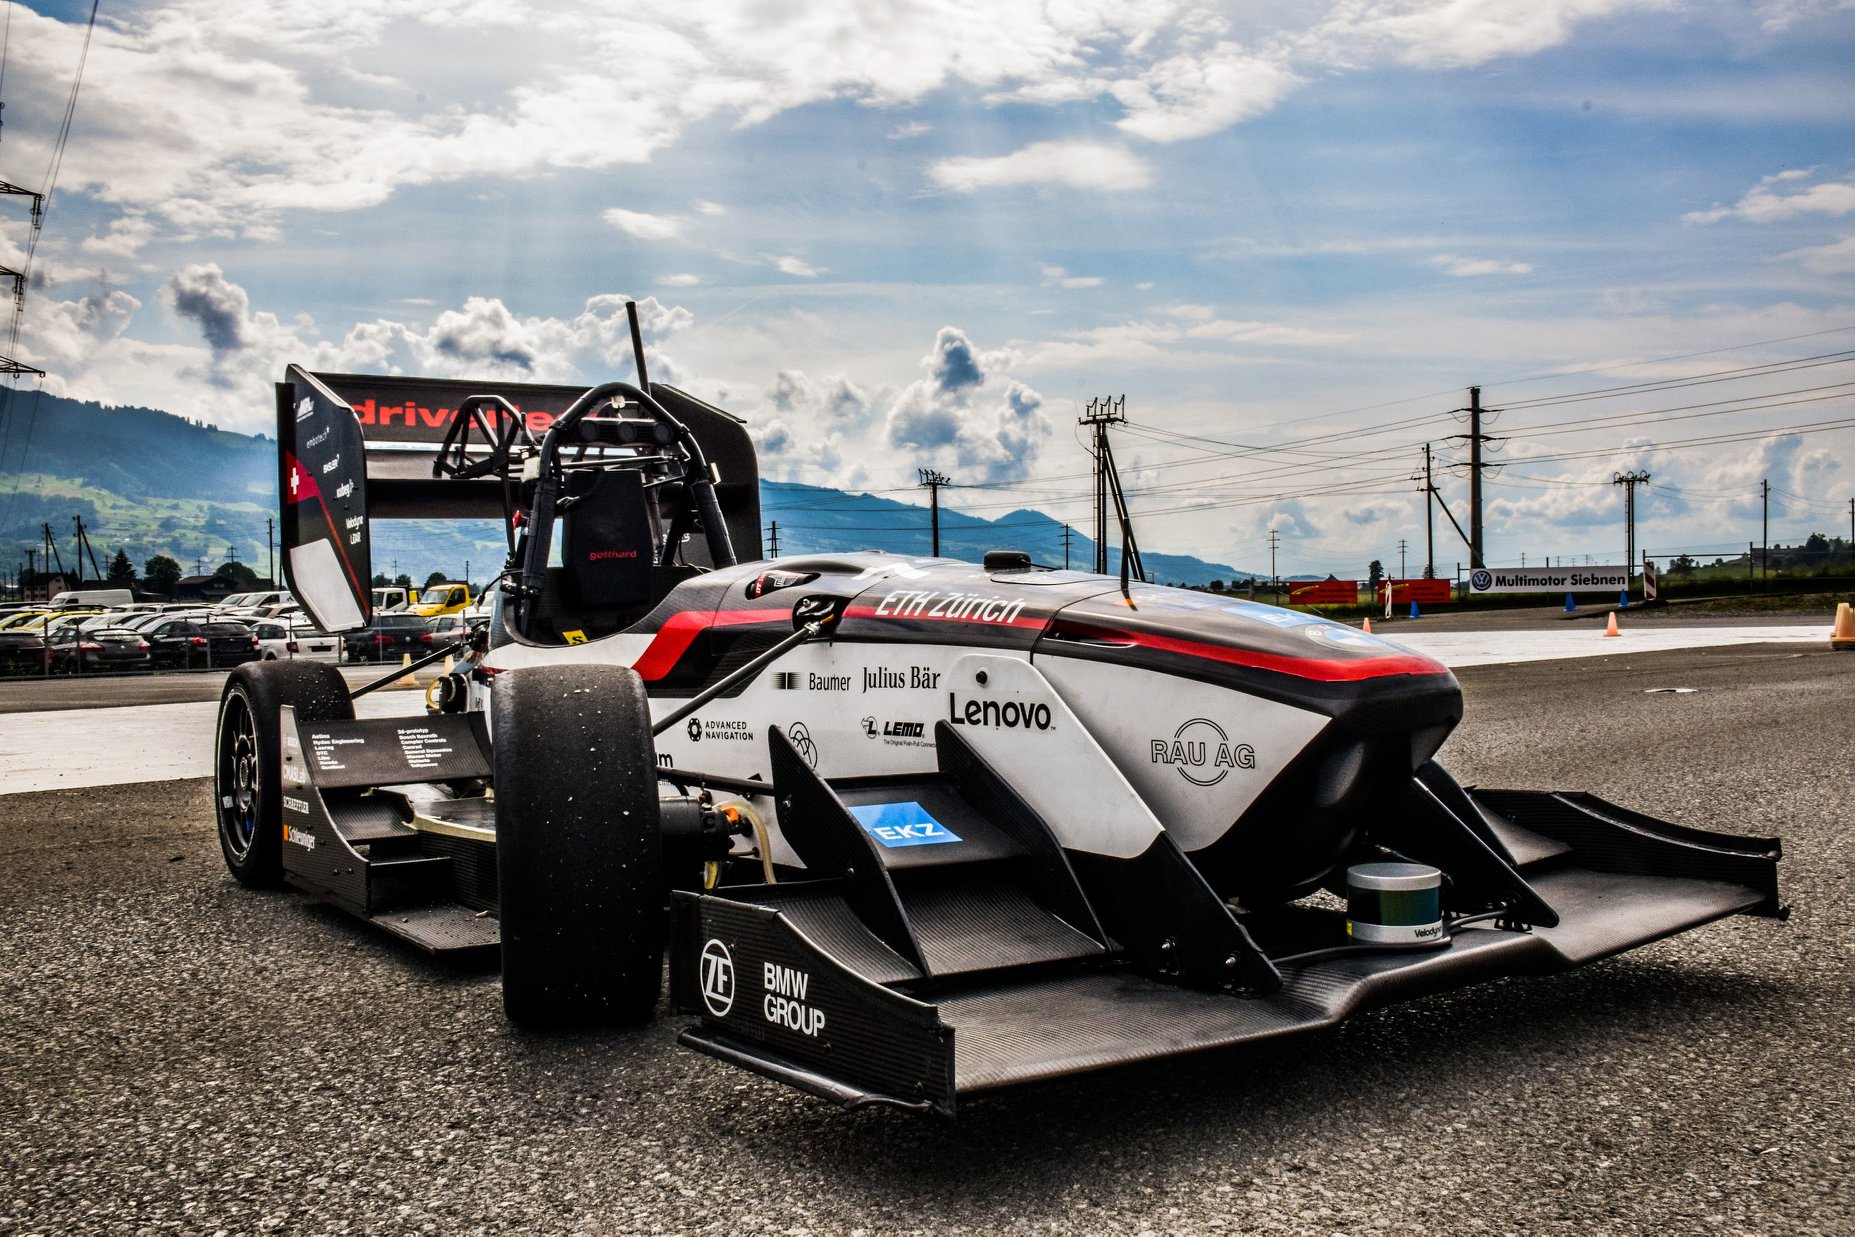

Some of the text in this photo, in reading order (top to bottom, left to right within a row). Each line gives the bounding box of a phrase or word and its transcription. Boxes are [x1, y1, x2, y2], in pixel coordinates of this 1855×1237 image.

[589, 550, 637, 560] gotthard
[1495, 574, 1567, 587] Multimotor
[1570, 573, 1626, 586] Siebnen
[875, 590, 1027, 623] ETH Zürich
[809, 672, 851, 691] Baumer
[863, 665, 941, 693] Julius Bär
[950, 692, 1051, 731] Lenovo
[705, 721, 747, 730] ADVANCED
[705, 731, 754, 741] NAVIGATION
[883, 721, 925, 738] LEMO
[1151, 740, 1256, 769] RAU AG
[873, 823, 945, 840] EKZ
[702, 951, 734, 1007] ZF
[764, 962, 809, 1001] BMW
[764, 994, 826, 1038] GROUP
